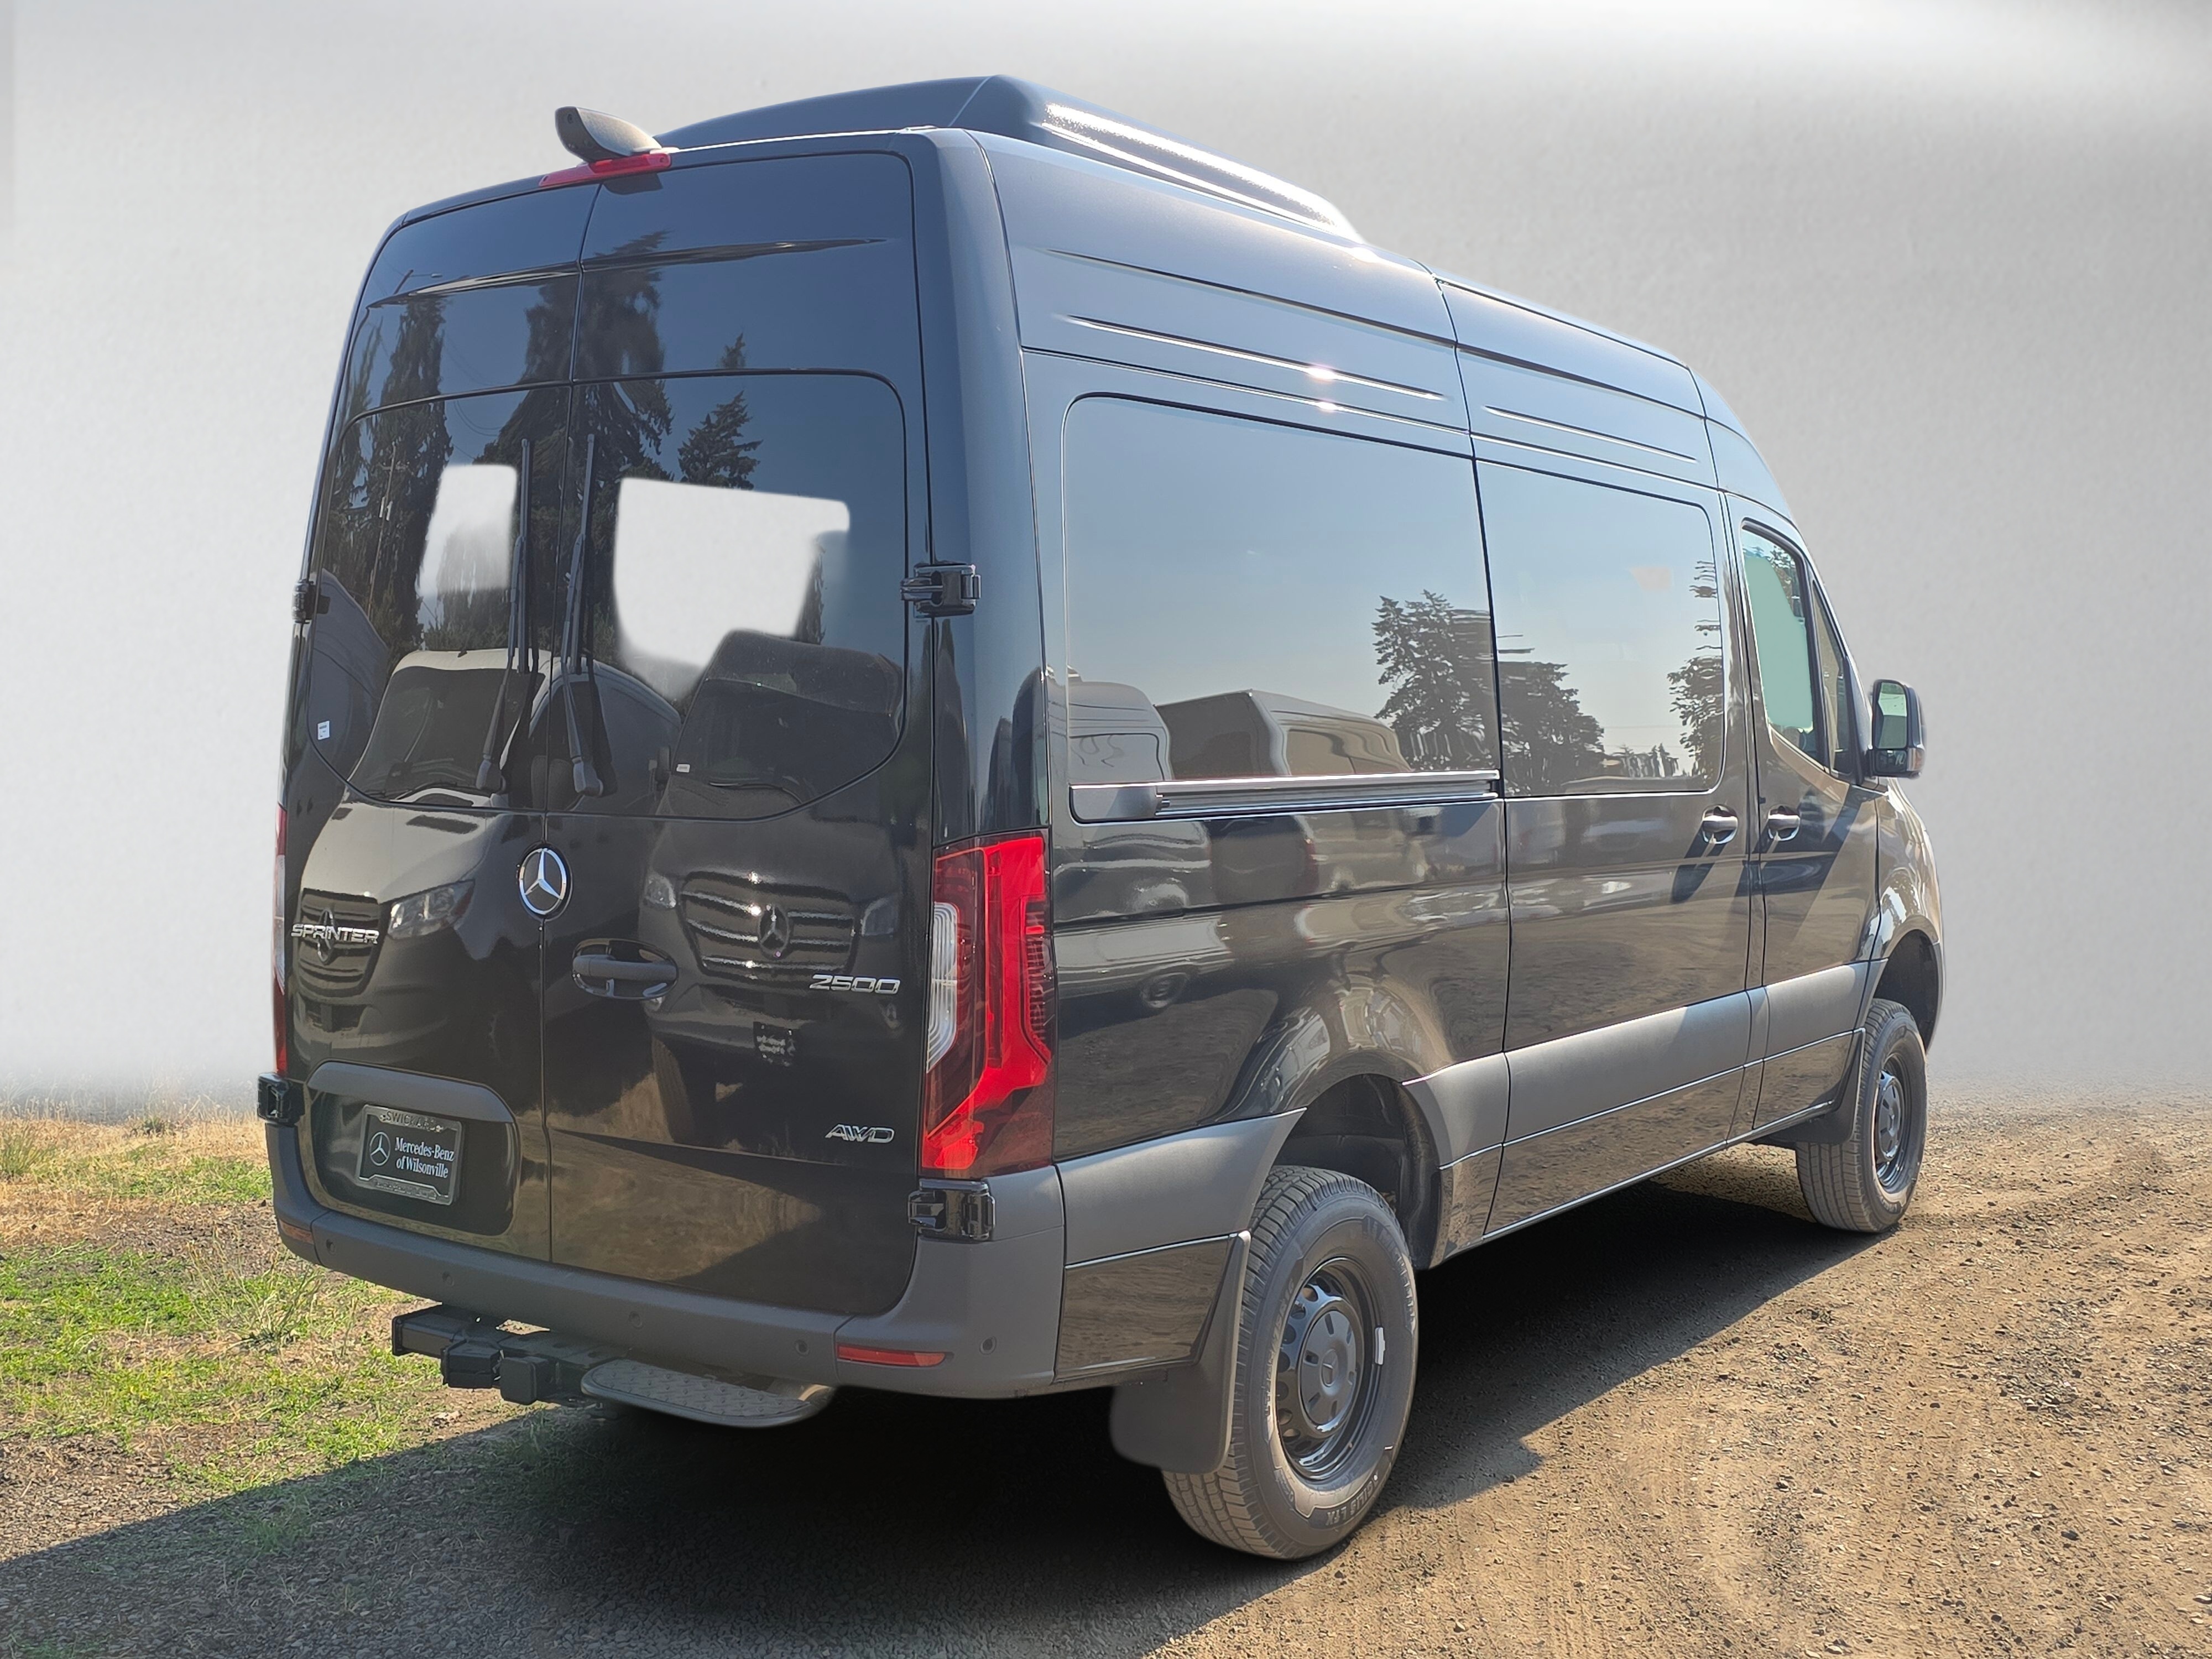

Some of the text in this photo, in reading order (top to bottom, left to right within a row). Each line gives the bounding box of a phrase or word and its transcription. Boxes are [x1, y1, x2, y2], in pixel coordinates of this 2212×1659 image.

[291, 924, 379, 945] SPRINTER
[809, 974, 901, 994] 2500
[825, 1124, 895, 1143] AWD
[395, 1136, 455, 1162] Mercedes-Benz
[396, 1155, 448, 1179] of Wilsonville
